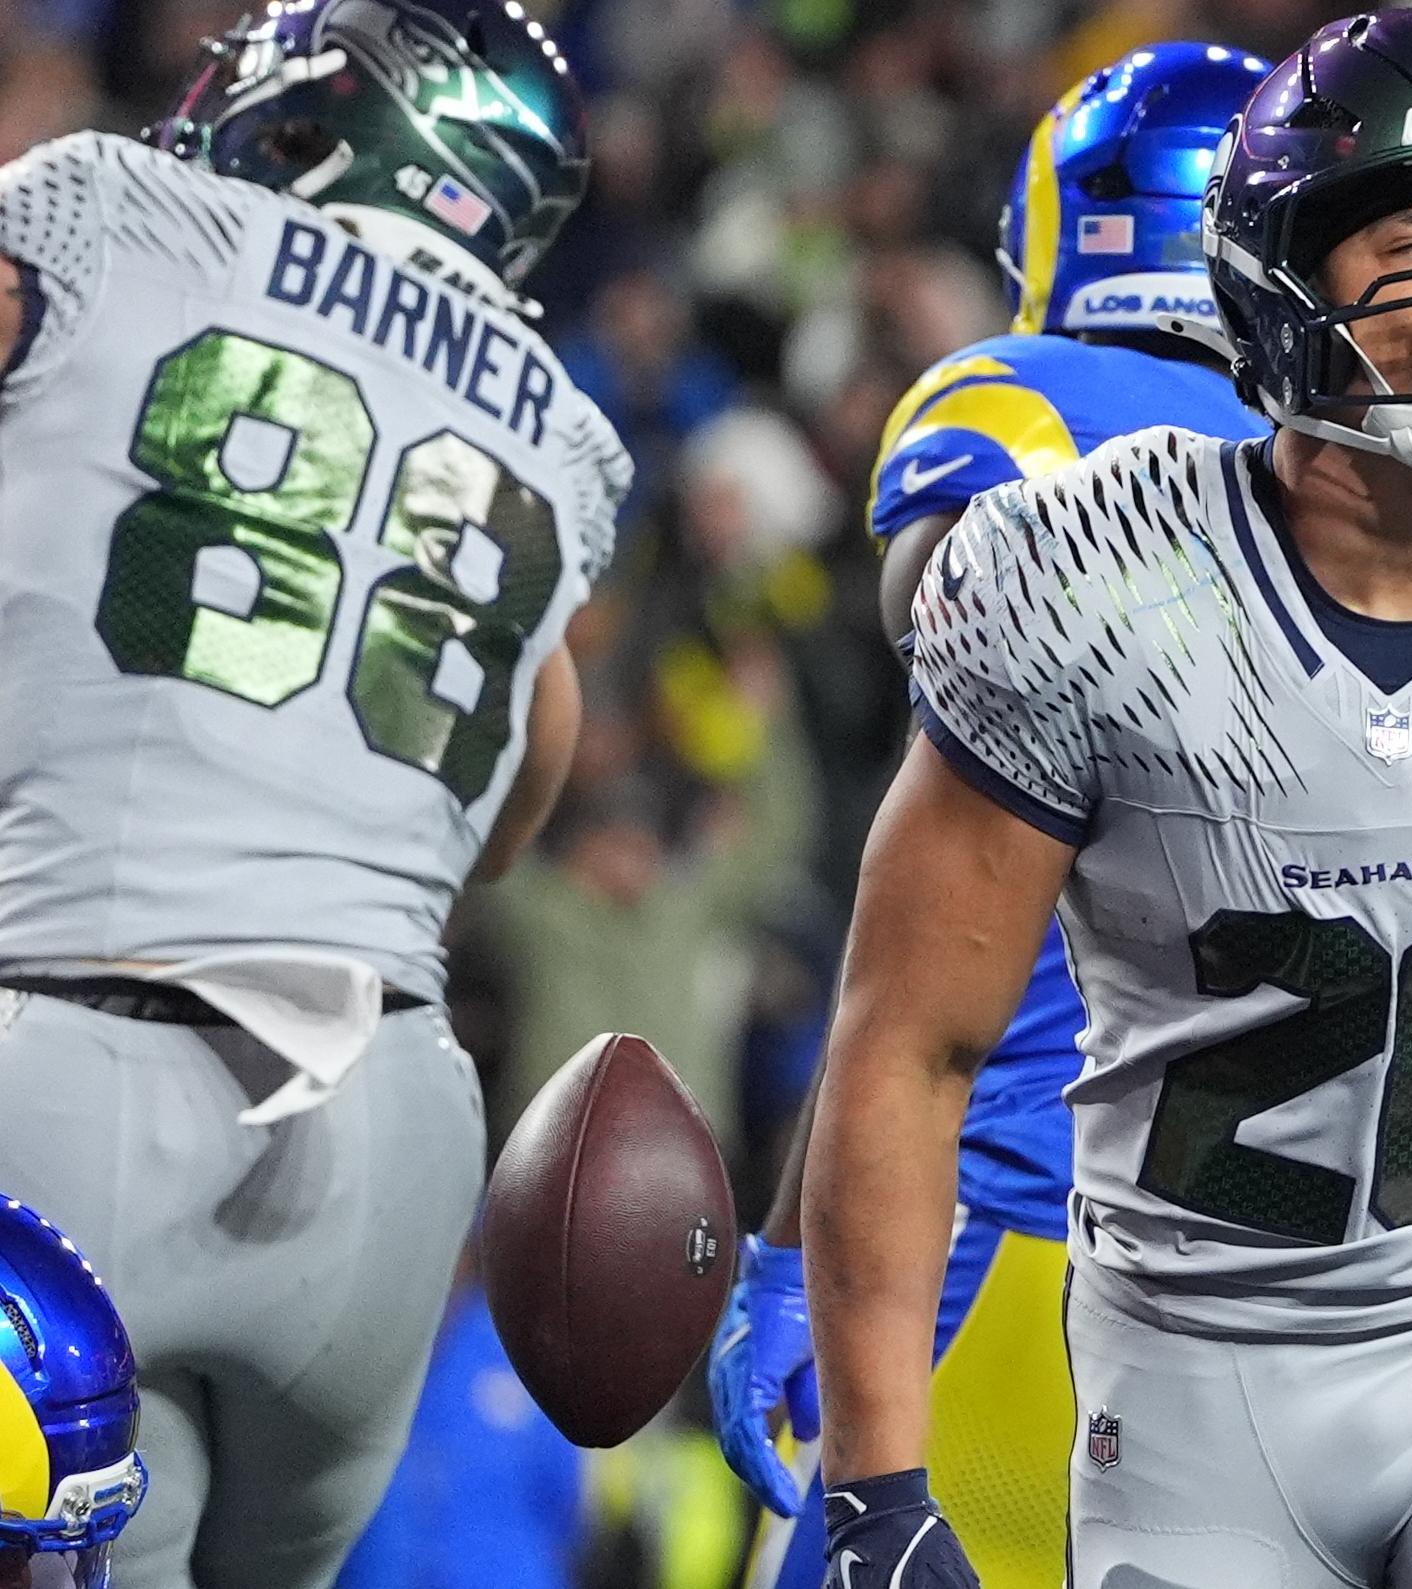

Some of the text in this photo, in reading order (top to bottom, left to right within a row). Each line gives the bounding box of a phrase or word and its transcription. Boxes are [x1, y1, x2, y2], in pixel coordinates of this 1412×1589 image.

[265, 219, 555, 447] BARNER
[1085, 294, 1142, 314] LOS
[95, 326, 563, 808] 88
[1092, 1435, 1117, 1459] NFL
